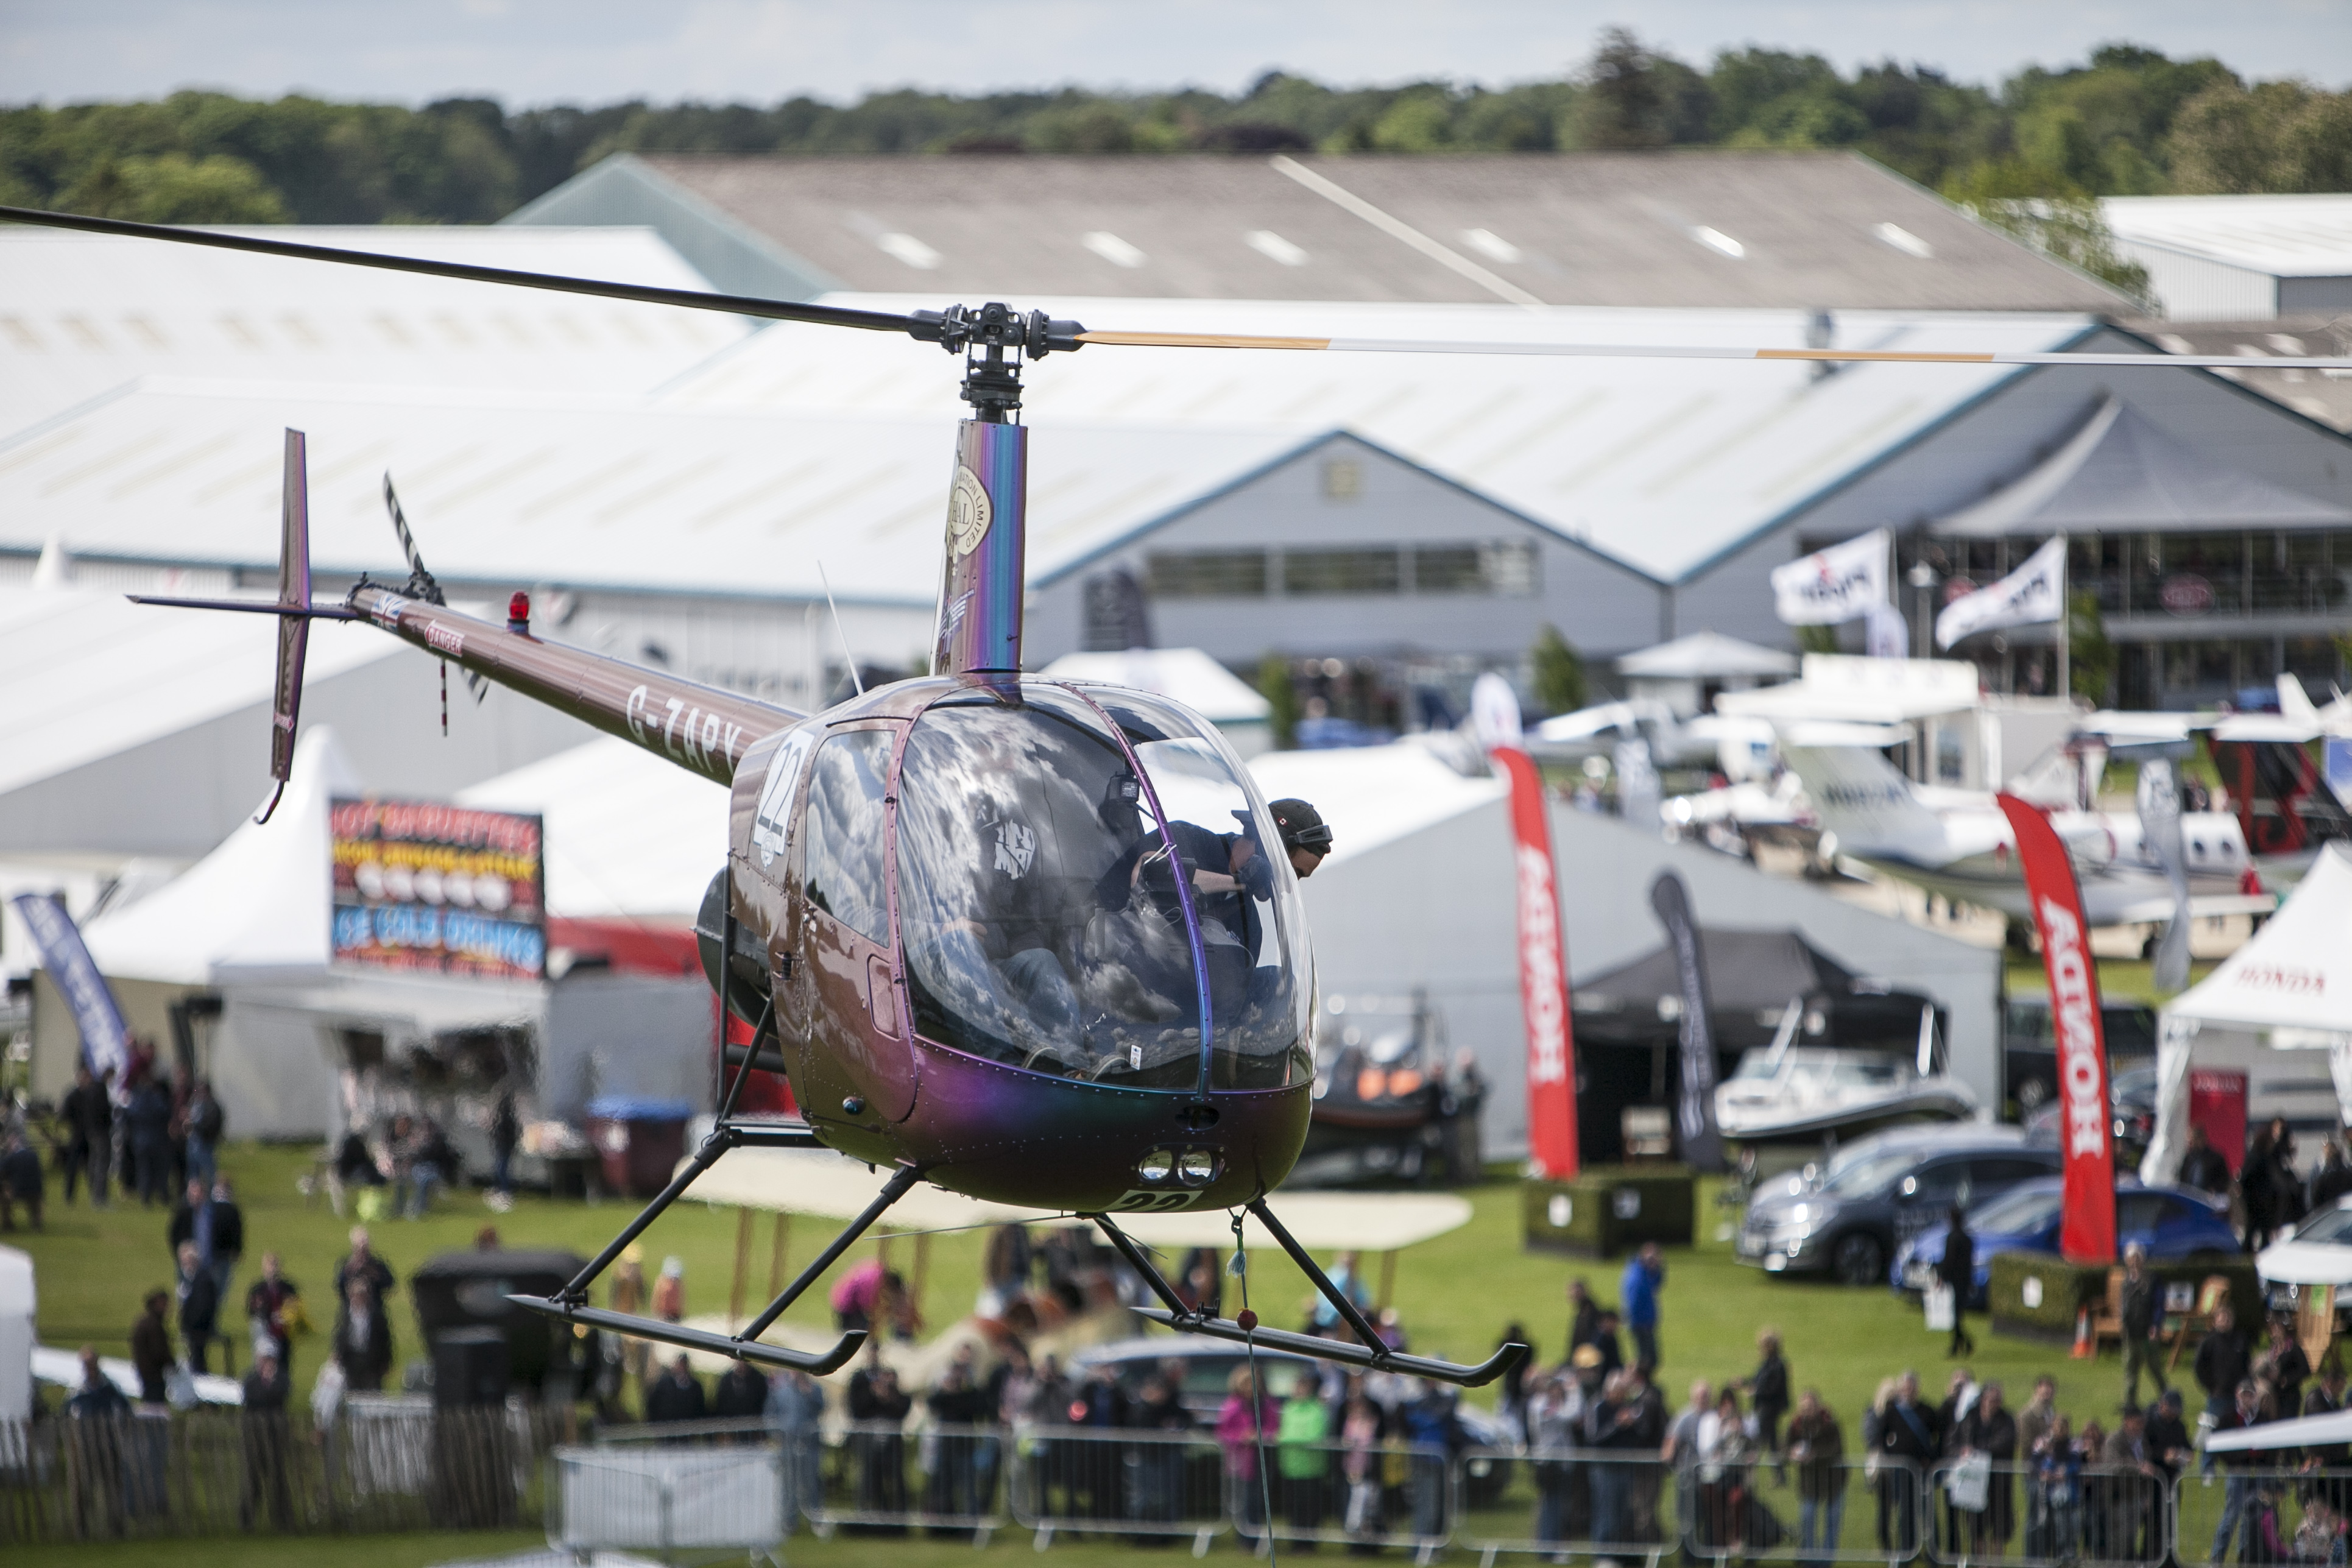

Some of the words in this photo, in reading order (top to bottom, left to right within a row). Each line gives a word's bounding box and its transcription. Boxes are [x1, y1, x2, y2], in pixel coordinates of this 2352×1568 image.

[952, 501, 969, 524] HAL
[966, 495, 984, 548] LIMITED
[428, 627, 462, 654] DANGER
[627, 685, 742, 776] G-ZAPY
[758, 741, 802, 837] 22
[2039, 892, 2104, 1159] HONDA
